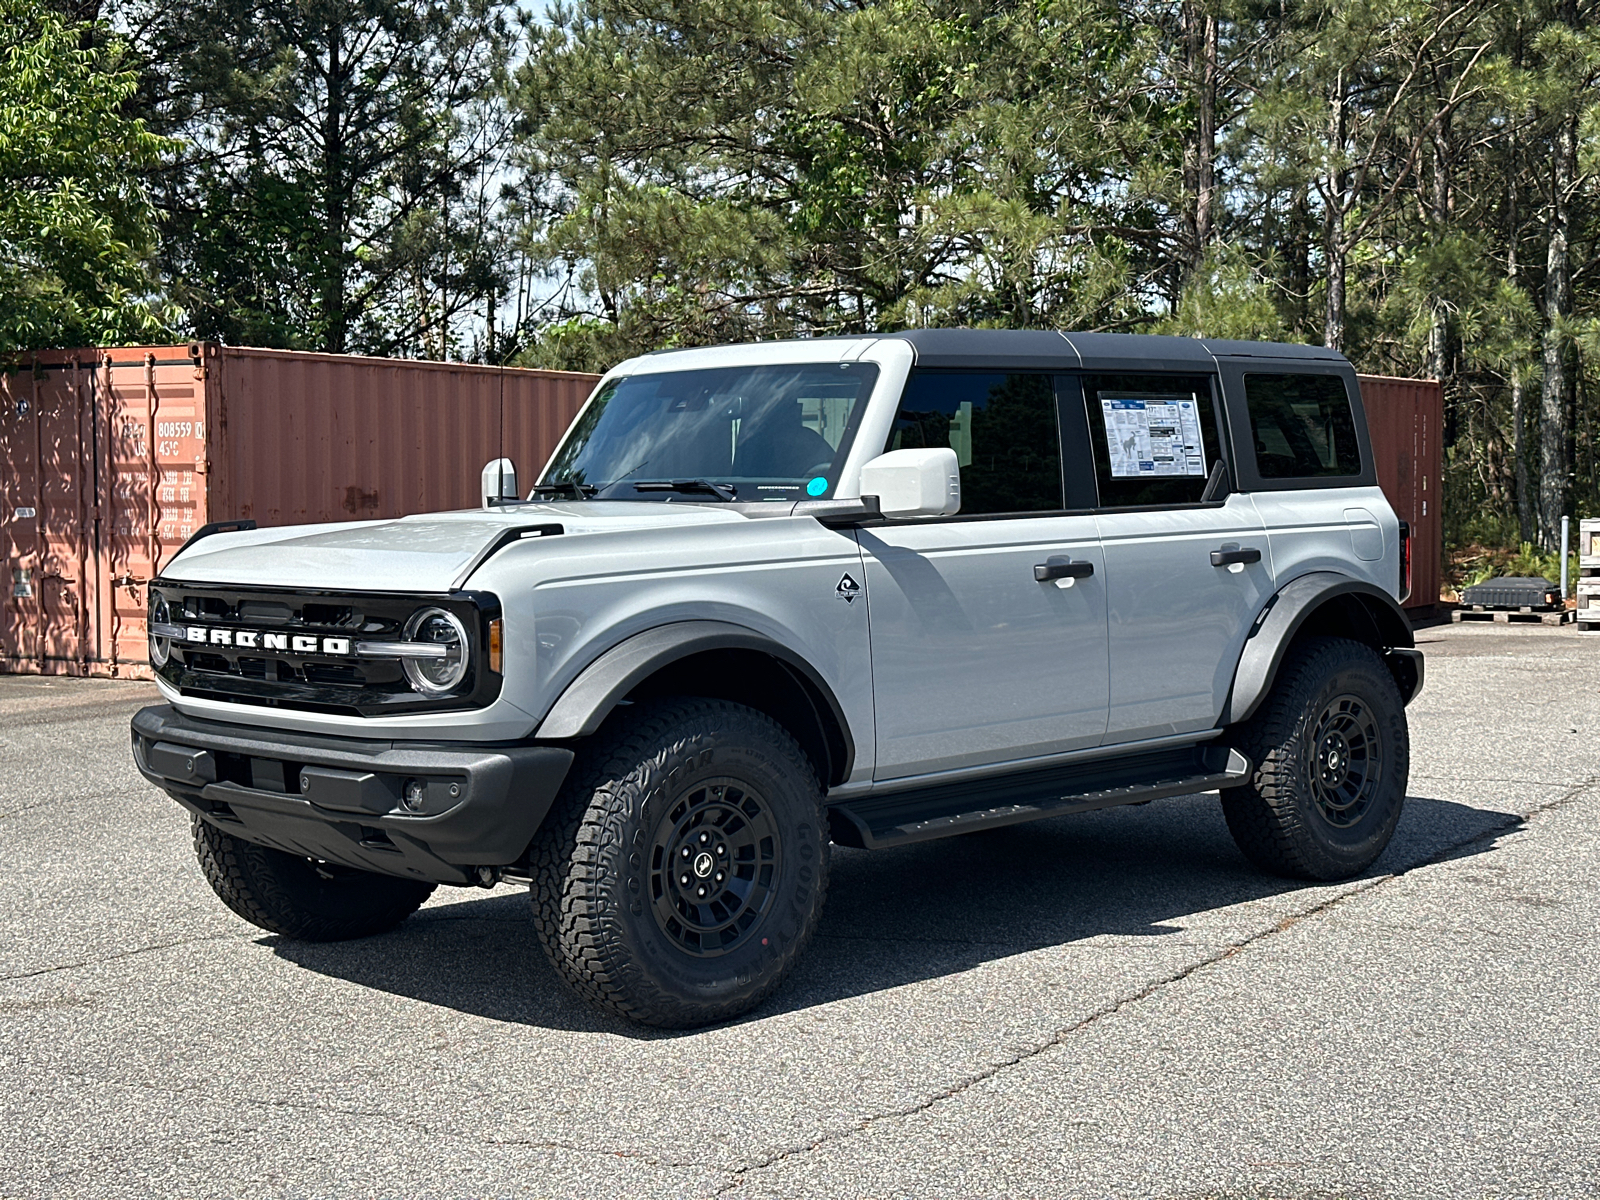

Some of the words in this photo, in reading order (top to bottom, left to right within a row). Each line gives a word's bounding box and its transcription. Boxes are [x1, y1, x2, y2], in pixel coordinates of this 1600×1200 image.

[158, 422, 192, 438] 808559
[135, 441, 146, 457] US
[187, 626, 350, 655] BRONCO
